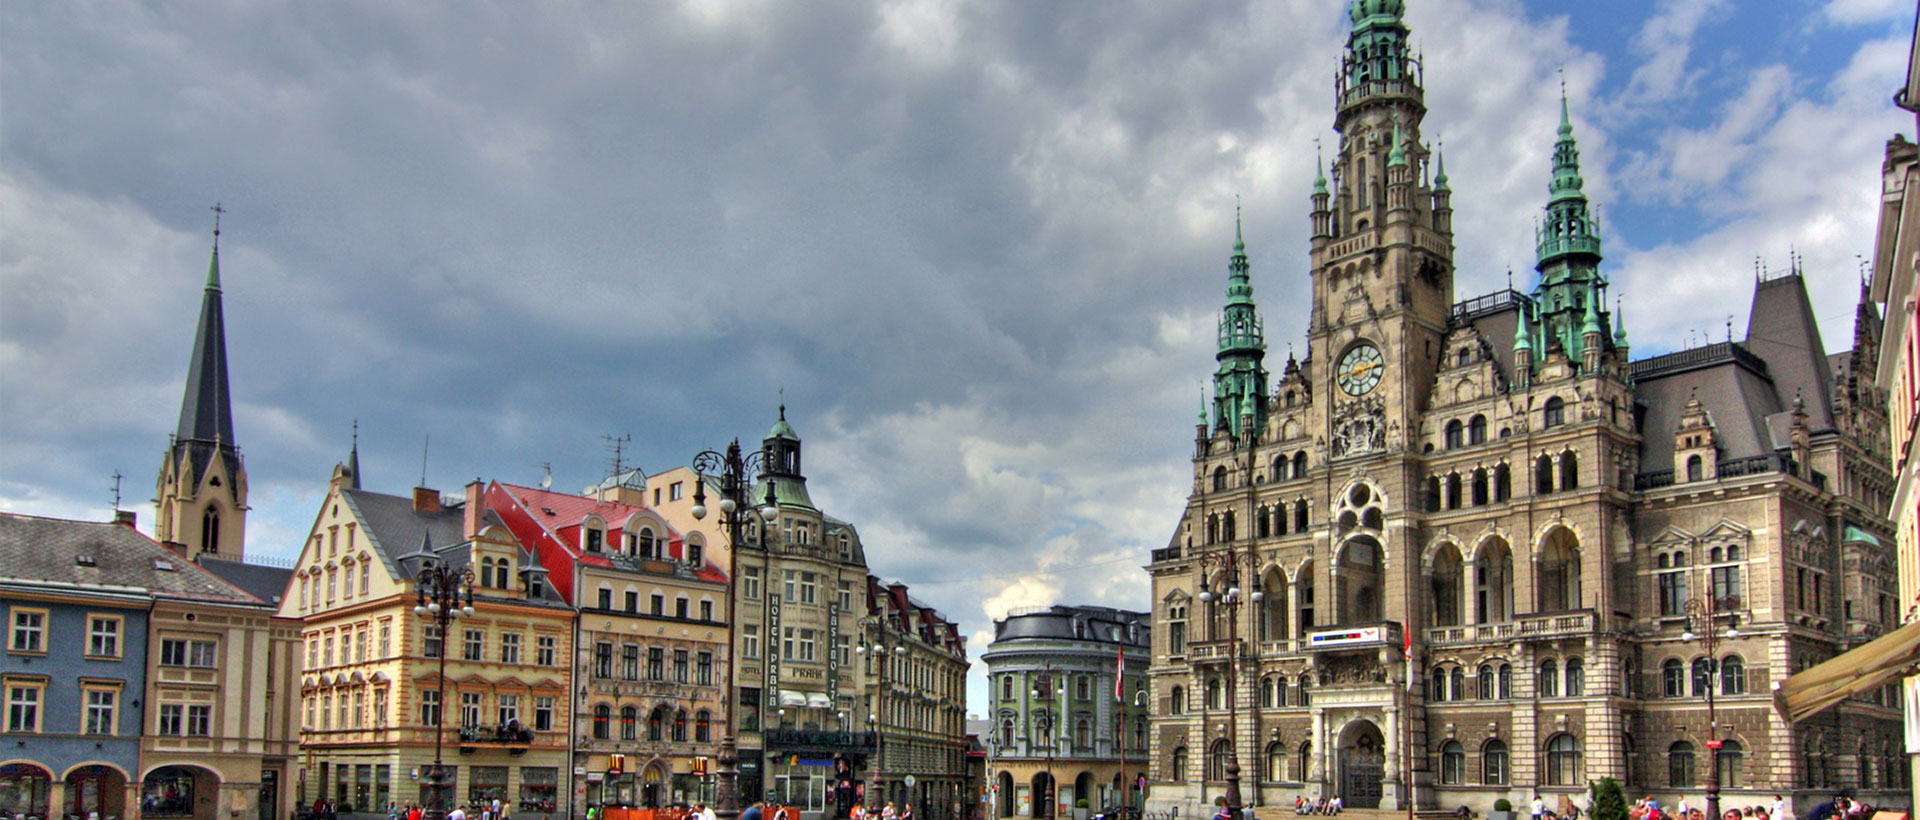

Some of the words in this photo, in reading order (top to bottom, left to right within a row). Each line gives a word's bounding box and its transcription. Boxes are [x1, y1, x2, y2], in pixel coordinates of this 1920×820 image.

[771, 596, 779, 647] HOTEL
[769, 653, 778, 707] PRAHA
[792, 668, 824, 679] PRAHA
